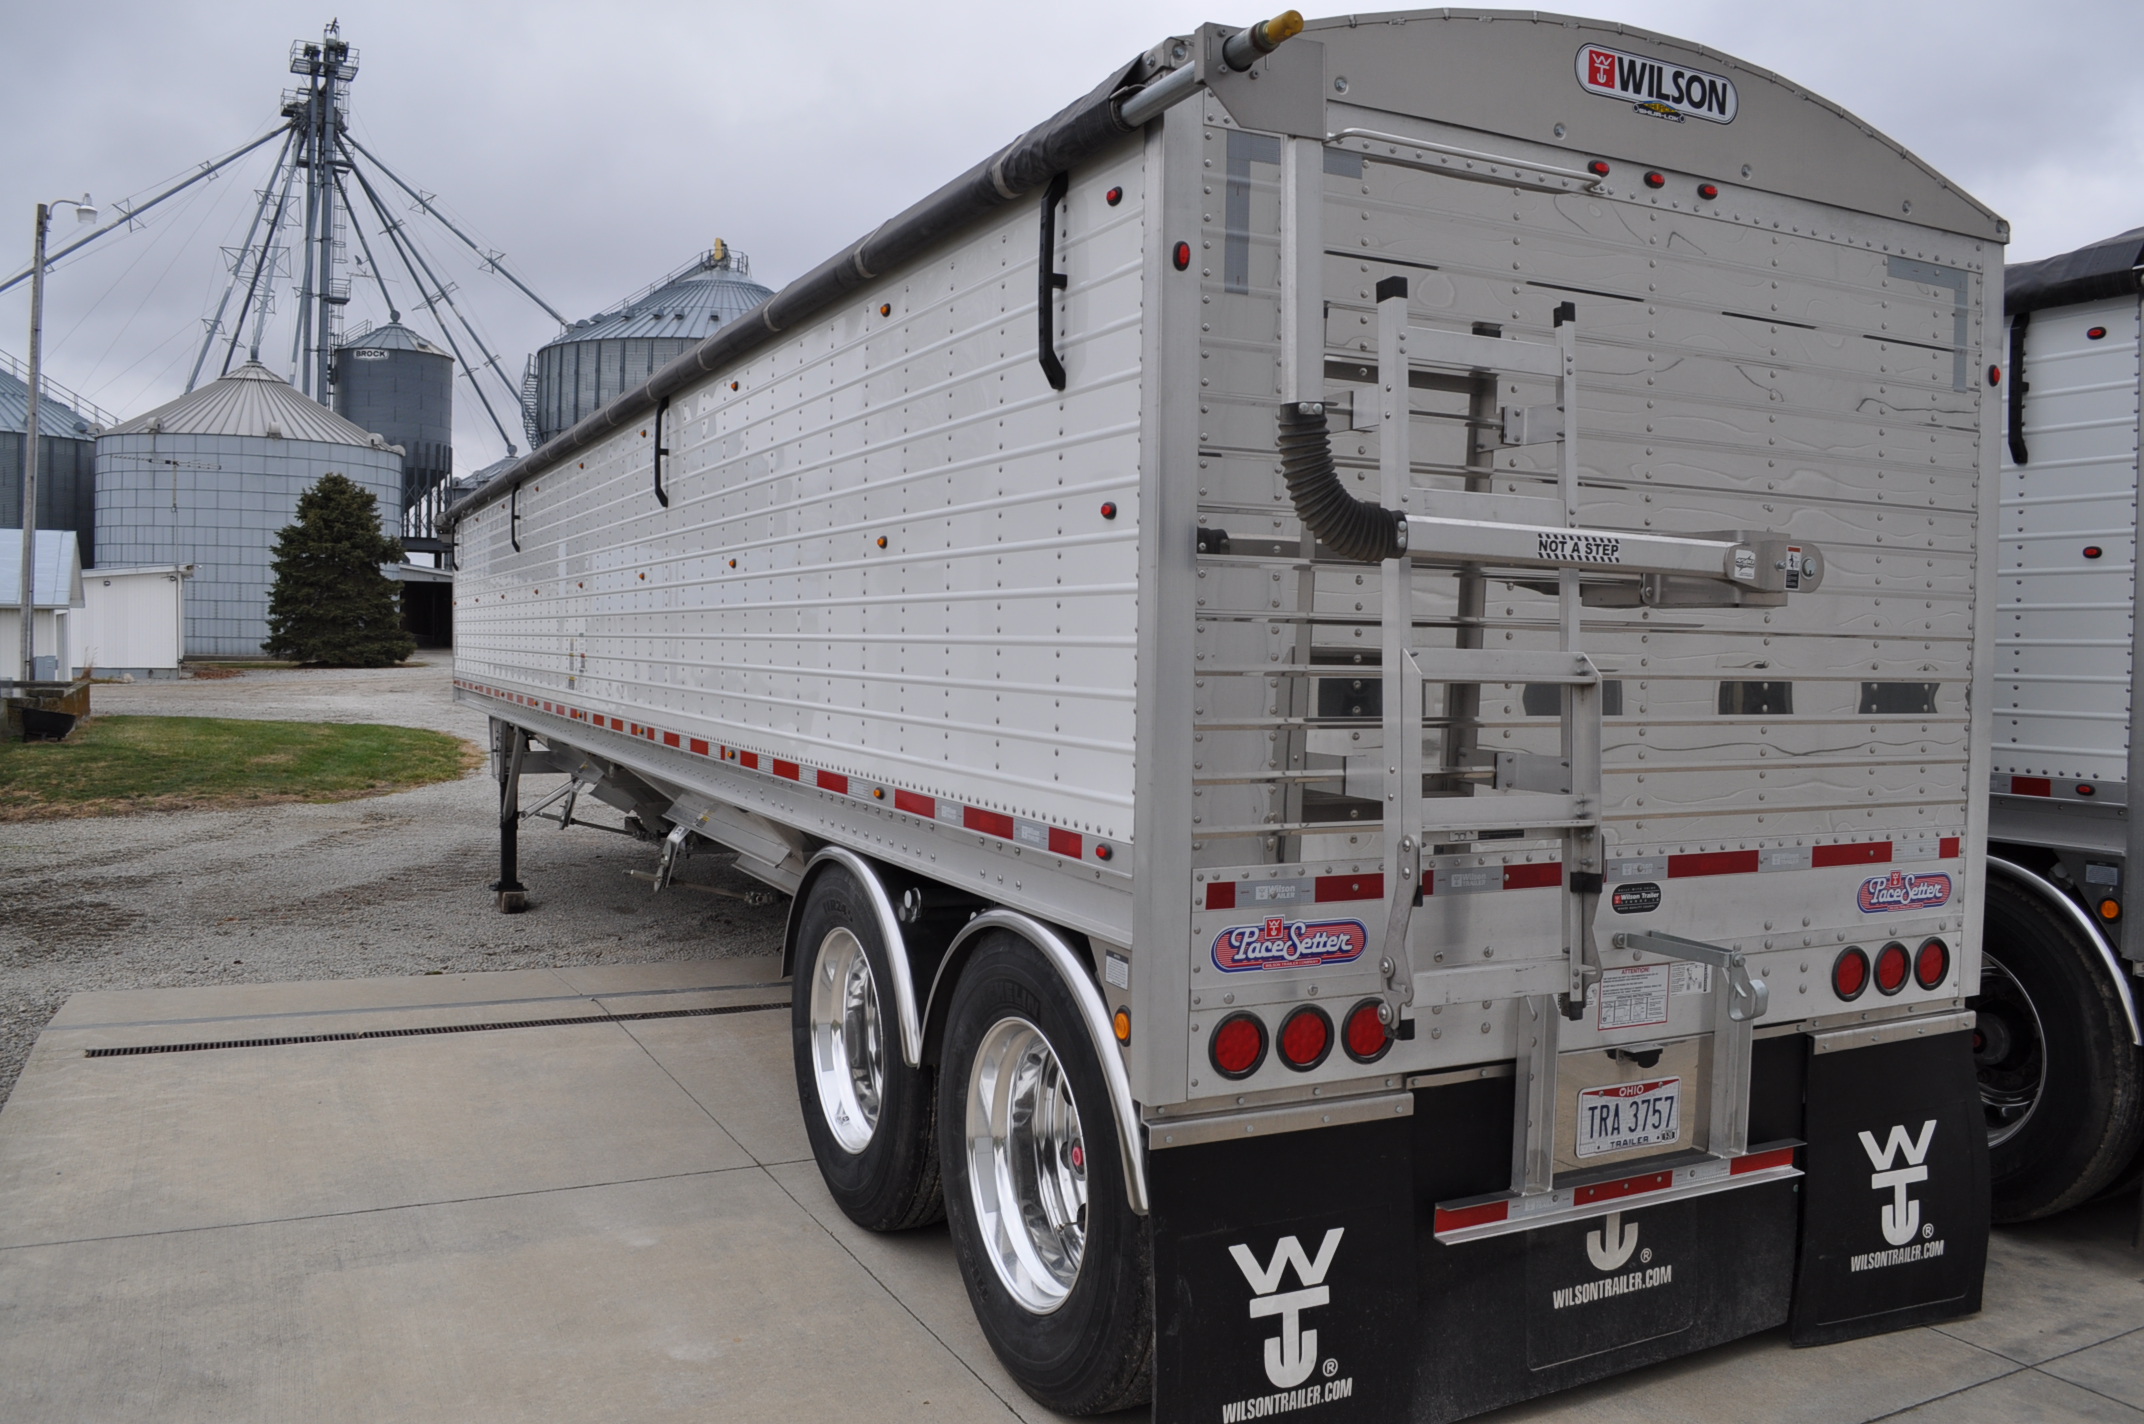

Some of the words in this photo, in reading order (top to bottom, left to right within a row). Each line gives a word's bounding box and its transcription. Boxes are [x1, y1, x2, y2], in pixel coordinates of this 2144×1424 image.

[1617, 56, 1727, 116] WILSON
[356, 350, 385, 358] BROCK
[1538, 539, 1567, 553] NOT
[1571, 542, 1580, 554] A
[1585, 543, 1619, 556] STEP
[1463, 873, 1487, 881] Wilson
[1268, 885, 1296, 893] Wilson
[1621, 967, 1651, 975] ATTENTION!
[1619, 1085, 1644, 1097] OHIO
[1588, 1103, 1620, 1139] TRA
[1628, 1095, 1674, 1133] 3757
[1610, 1136, 1649, 1148] TRAILER
[1850, 1240, 1945, 1273] WILSONTRAILER.COM
[1552, 1264, 1672, 1310] WILSONTRAILER.COM
[1222, 1377, 1353, 1424] WILSONTRAILER.COM
